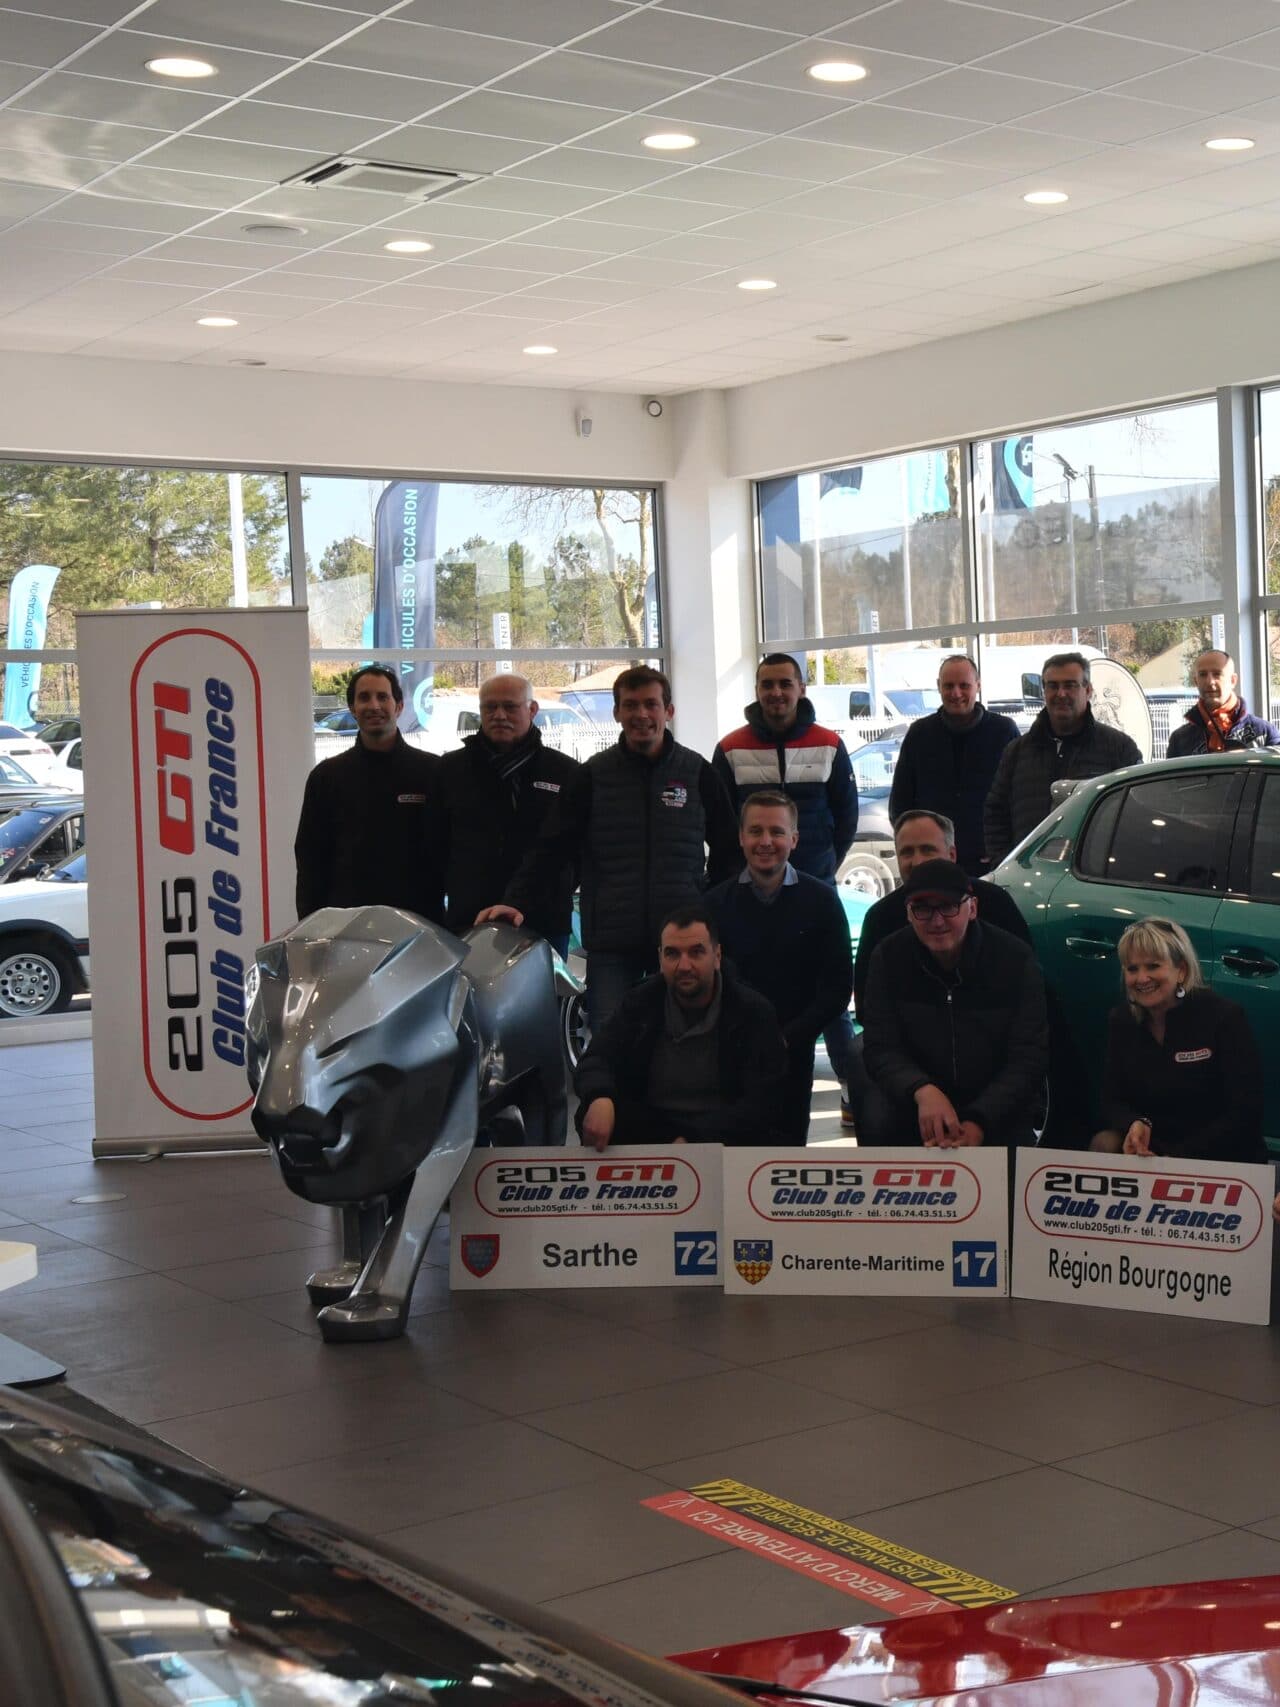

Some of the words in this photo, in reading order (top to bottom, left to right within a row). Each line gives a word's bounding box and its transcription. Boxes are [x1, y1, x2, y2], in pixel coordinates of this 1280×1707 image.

[402, 488, 418, 584] D'OCCASION
[401, 588, 416, 675] VHICULES
[500, 615, 510, 670] PTNER
[21, 638, 33, 688] VÉHICES
[153, 681, 195, 855] GTI
[205, 677, 239, 856] France
[207, 869, 243, 936] de
[161, 876, 204, 1072] 205
[210, 949, 245, 1067] Club
[496, 1166, 586, 1184] 205
[596, 1164, 676, 1182] GTI
[771, 1168, 863, 1186] 205
[872, 1168, 956, 1187] GTI
[499, 1184, 553, 1202] Club
[559, 1185, 588, 1200] de
[596, 1183, 678, 1199] France
[772, 1187, 829, 1205] Club
[834, 1188, 866, 1205] de
[872, 1188, 958, 1206] France
[1044, 1172, 1139, 1198] 205
[1150, 1179, 1243, 1207] GTI
[498, 1204, 578, 1214] www.club205gti.fr
[614, 1202, 679, 1211] 06.74.43.51.51
[771, 1209, 854, 1219] www.club205gti.fr
[890, 1210, 958, 1218] 06.74.43.51.51
[1043, 1194, 1101, 1218] Club
[1105, 1200, 1142, 1221] de
[1145, 1204, 1242, 1231] France
[1044, 1219, 1131, 1236] www.club205gti.fr
[1167, 1228, 1241, 1245] 06.74.43.51.51
[542, 1243, 638, 1268] Sarthe
[676, 1240, 717, 1266] 72
[781, 1254, 945, 1272] Charente-Maritime
[954, 1251, 996, 1278] 17
[1048, 1248, 1112, 1289] Région
[1119, 1255, 1231, 1301] Bourgogne
[688, 1510, 723, 1525] ICI
[711, 1521, 840, 1573] D'ATTENDRE
[816, 1533, 850, 1547] DE
[884, 1545, 915, 1560] VIES
[839, 1543, 929, 1580] DISTANCE
[914, 1558, 944, 1571] DES
[827, 1570, 905, 1602] MERCI
[943, 1569, 1012, 1597] SAUVONS
